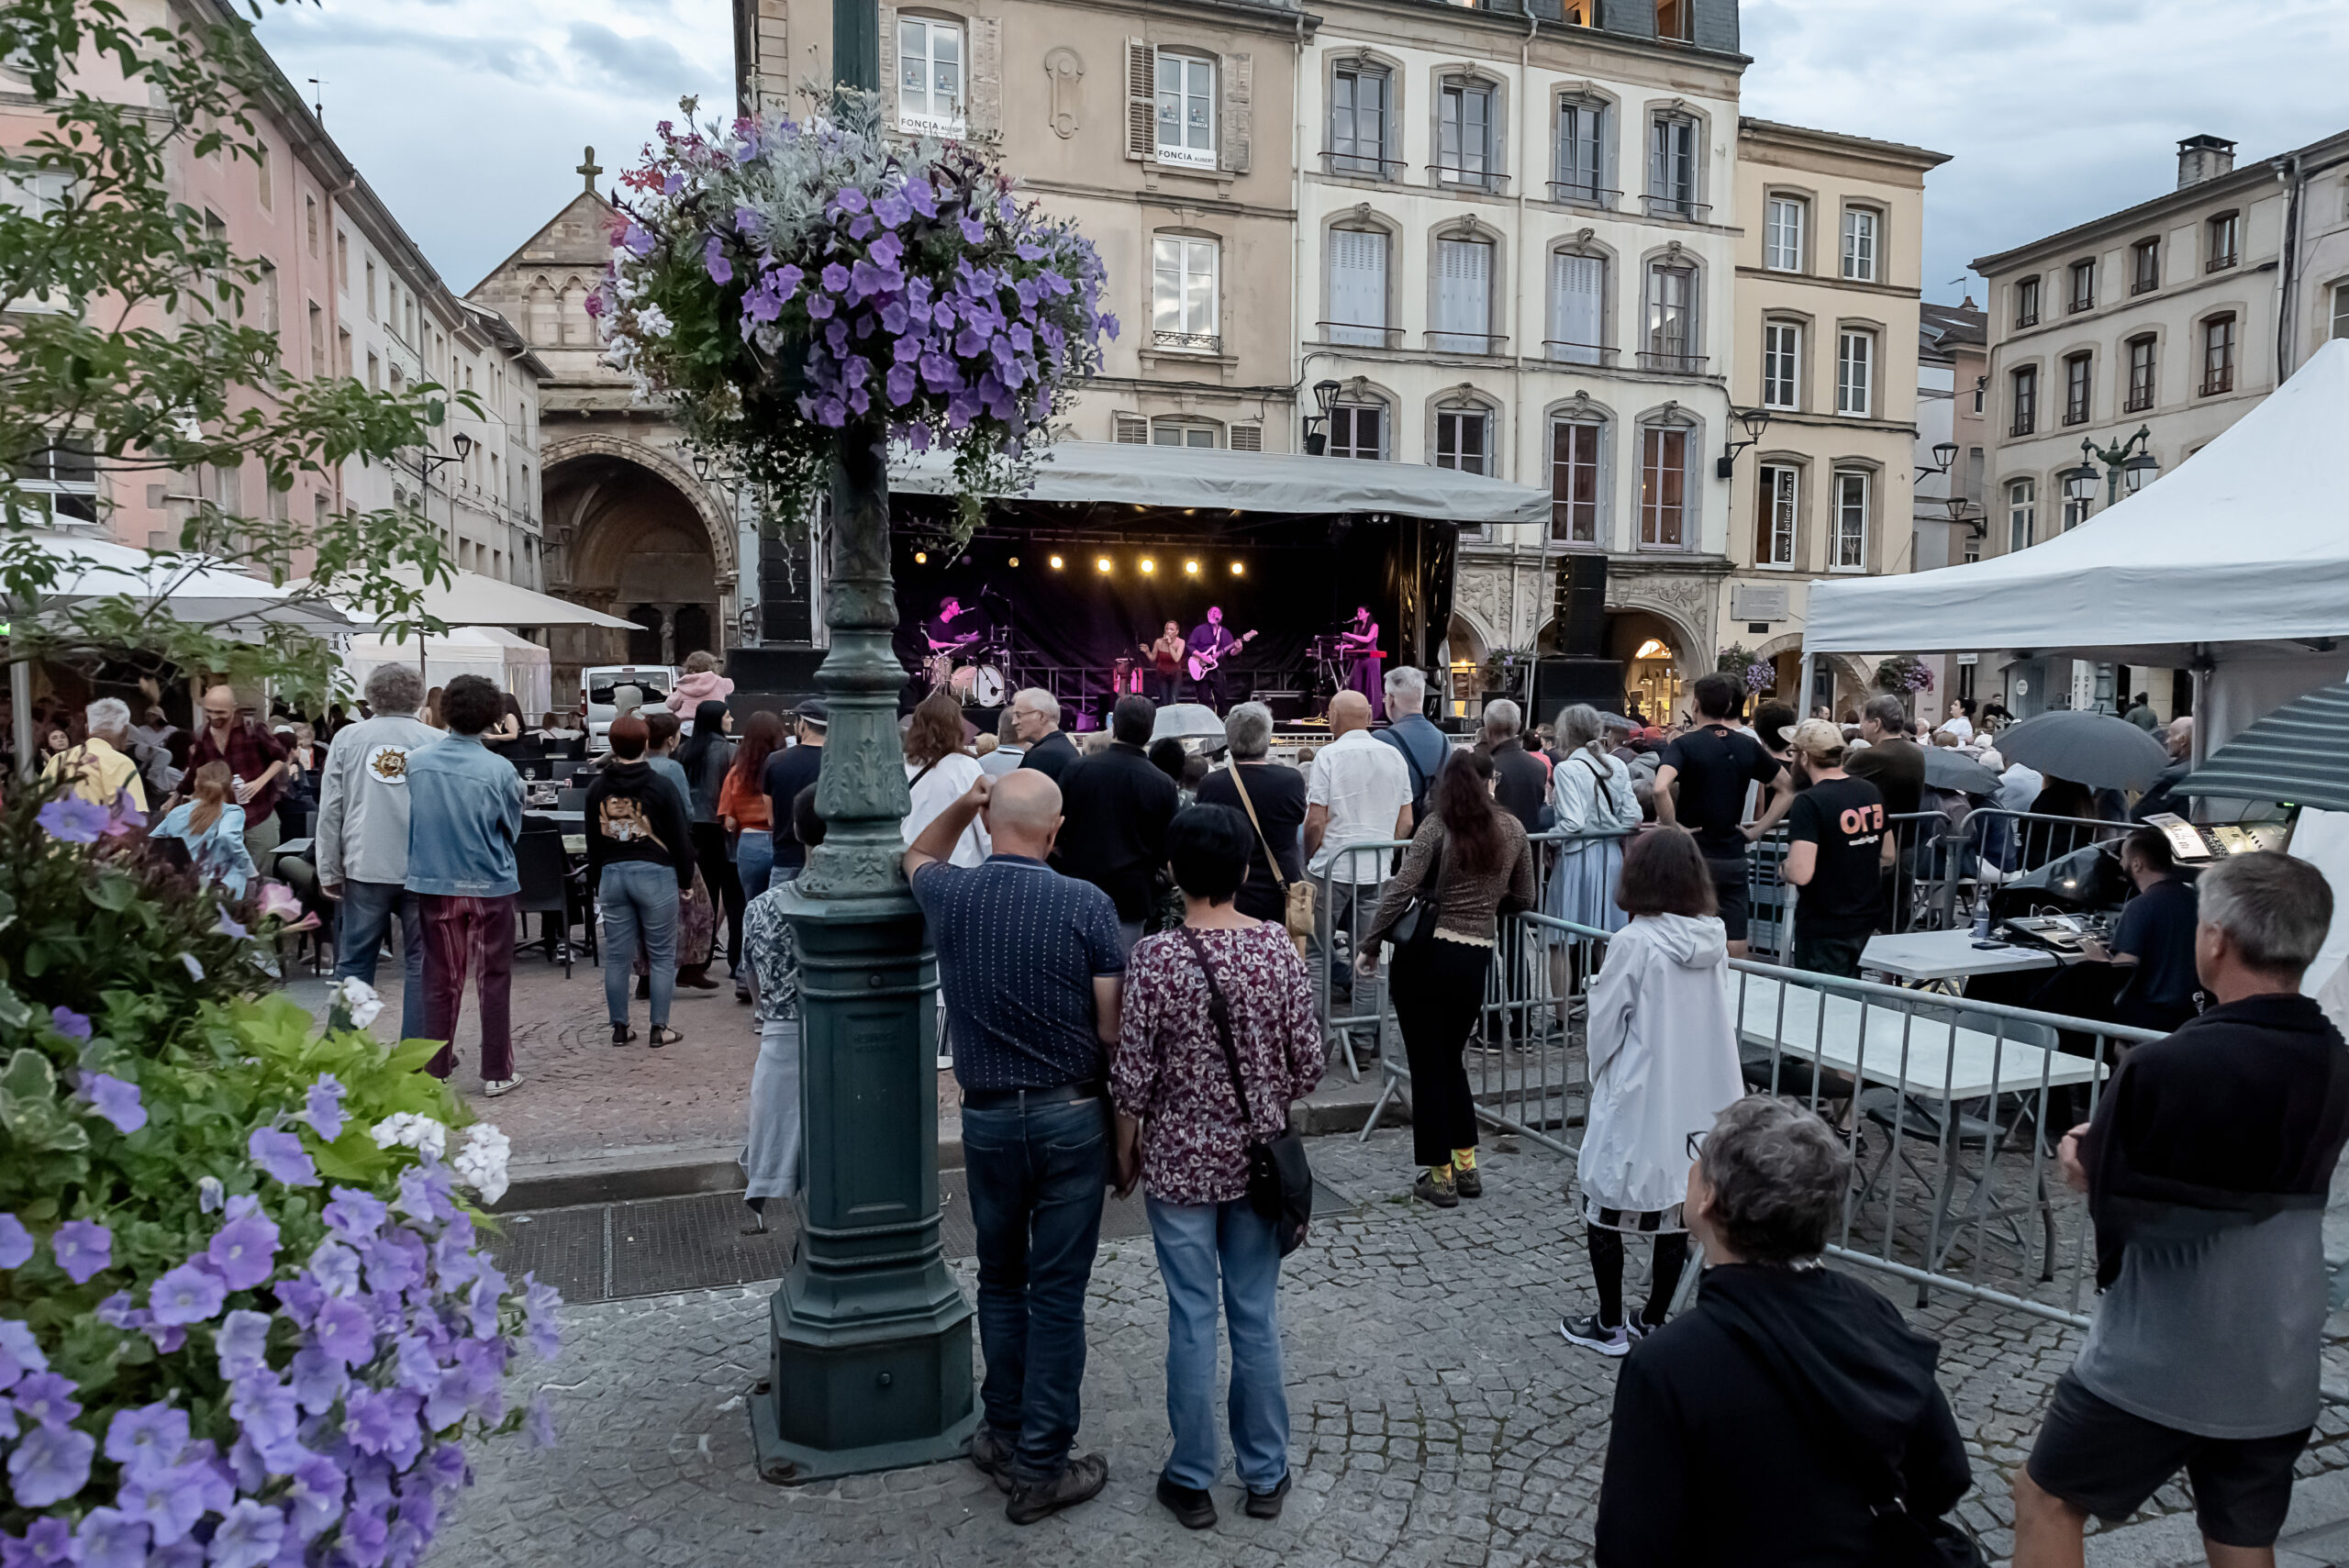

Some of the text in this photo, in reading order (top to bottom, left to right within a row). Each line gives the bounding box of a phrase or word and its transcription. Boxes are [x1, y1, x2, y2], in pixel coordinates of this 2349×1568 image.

[902, 83, 926, 93] FONCIA
[935, 88, 958, 96] FONCIA
[901, 117, 939, 130] FONCIA
[1159, 117, 1180, 126] FONCIA
[1158, 150, 1193, 161] FONCIA
